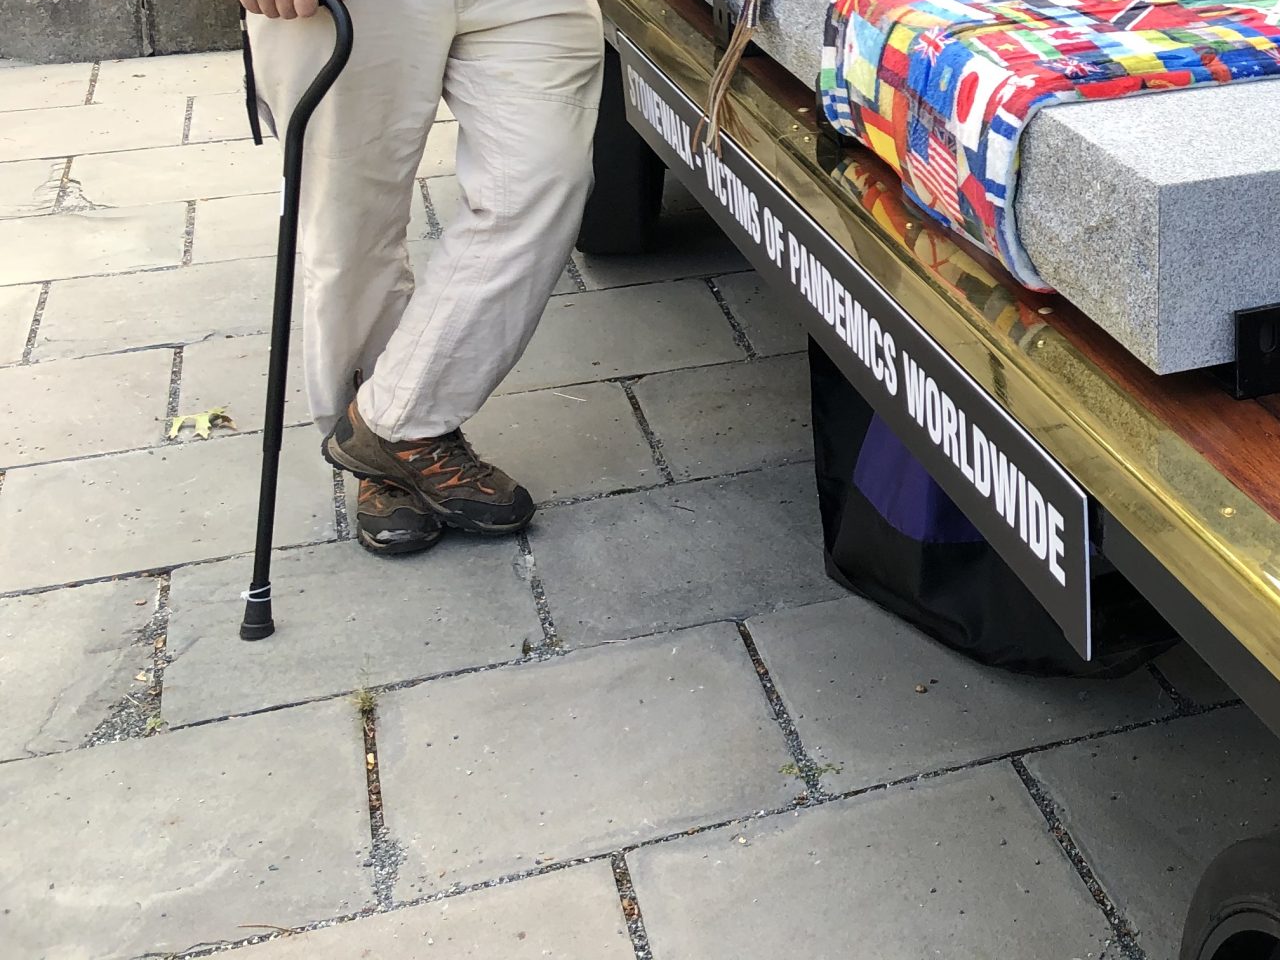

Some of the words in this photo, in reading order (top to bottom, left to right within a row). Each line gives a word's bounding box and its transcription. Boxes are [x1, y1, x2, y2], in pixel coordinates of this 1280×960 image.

[627, 64, 695, 170] STONEWALK
[701, 141, 761, 244] VICTIMS
[763, 206, 786, 270] OF
[789, 231, 898, 396] PANDEMICS
[902, 350, 1066, 587] WORLDWIDE
